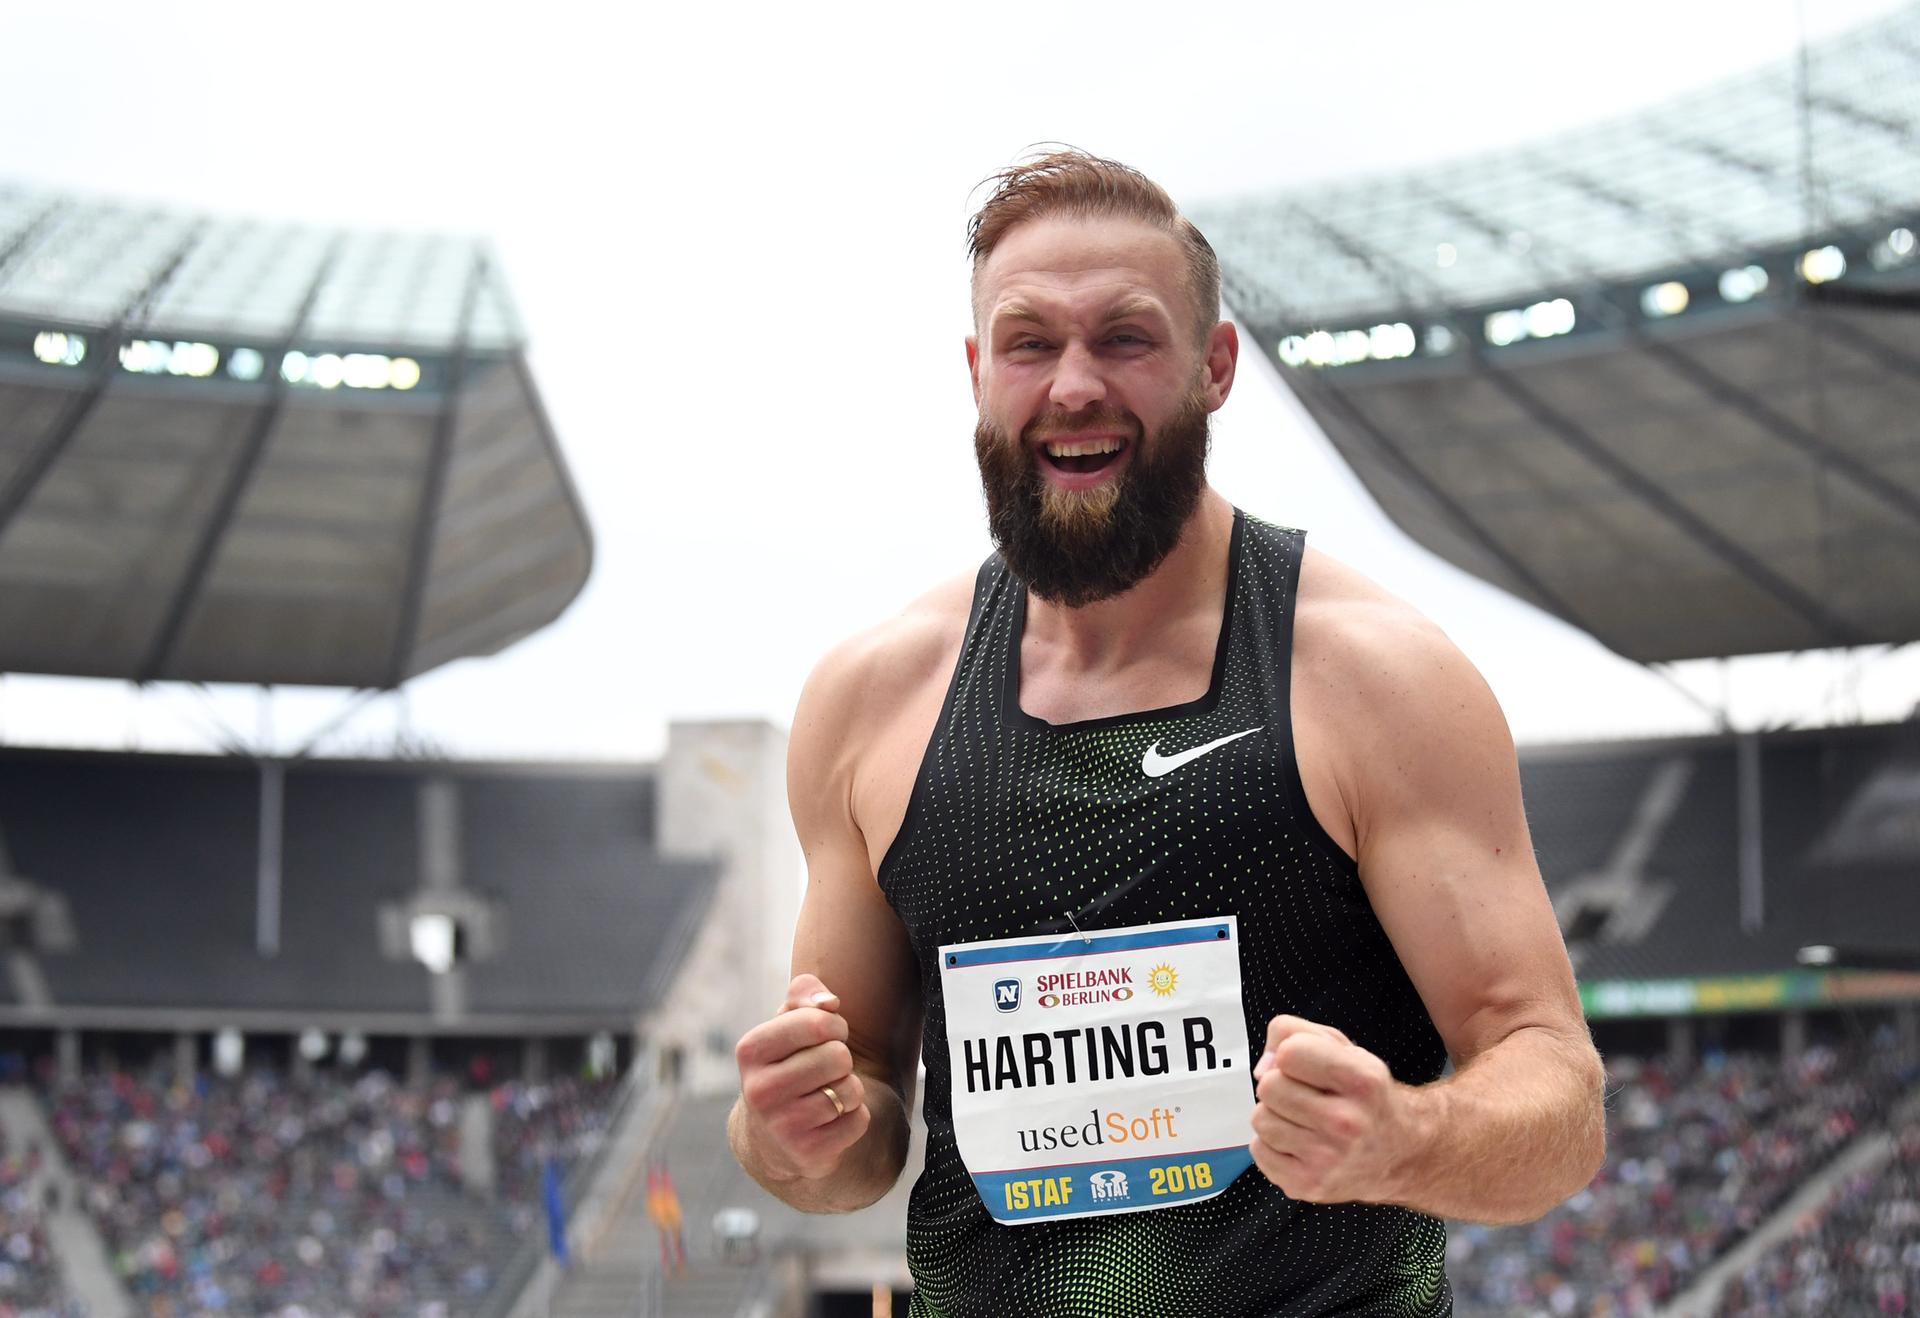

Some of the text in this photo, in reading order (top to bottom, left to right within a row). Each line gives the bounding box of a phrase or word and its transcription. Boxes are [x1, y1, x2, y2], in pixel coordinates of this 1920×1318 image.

[1036, 966, 1134, 993] SPIELBANK
[1062, 989, 1111, 1007] BERLIN
[963, 1016, 1233, 1094] HARTING R.
[1004, 1176, 1073, 1211] ISTAF
[1090, 1180, 1129, 1200] ISTAF
[1148, 1162, 1214, 1196] 2018
